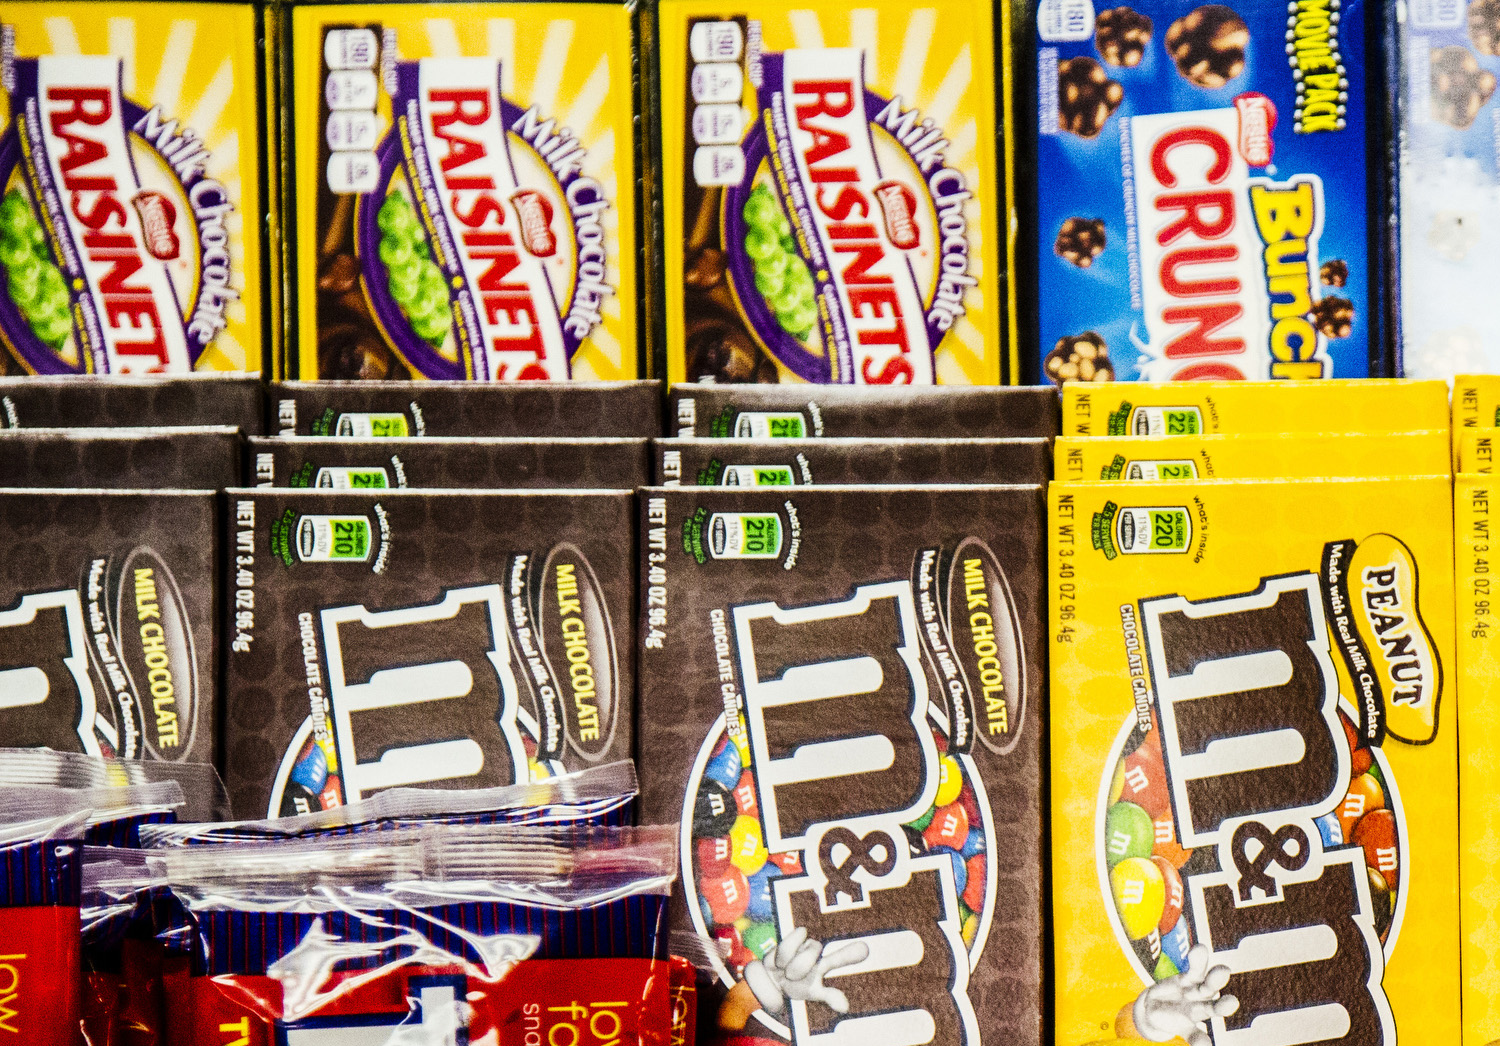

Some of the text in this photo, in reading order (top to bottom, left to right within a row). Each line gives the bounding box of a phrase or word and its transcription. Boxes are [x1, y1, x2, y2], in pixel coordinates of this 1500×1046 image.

[1302, 73, 1340, 134] PACK
[133, 104, 241, 344] Milk Chocolate
[511, 105, 624, 343] Milk Chocolate
[792, 79, 914, 384] RAISINETS
[874, 95, 978, 332] Milk Chocolate
[335, 522, 354, 555] 210
[645, 498, 667, 649] NET WT 3.40 OZ 96.4g
[747, 519, 766, 553] 210
[1155, 513, 1173, 547] 220
[1470, 490, 1490, 639] NET WT 3.40 OZ 96.4g
[134, 567, 179, 750] MILK CHOCOLATE
[556, 563, 600, 742] MILK CHOCOLATE
[710, 609, 741, 737] CHOCOLATE CANDIES
[919, 550, 971, 747] Made with Real Milk Chocolate
[963, 558, 1008, 735] MILK CHOCOLATE
[1365, 565, 1424, 706] PEANUT
